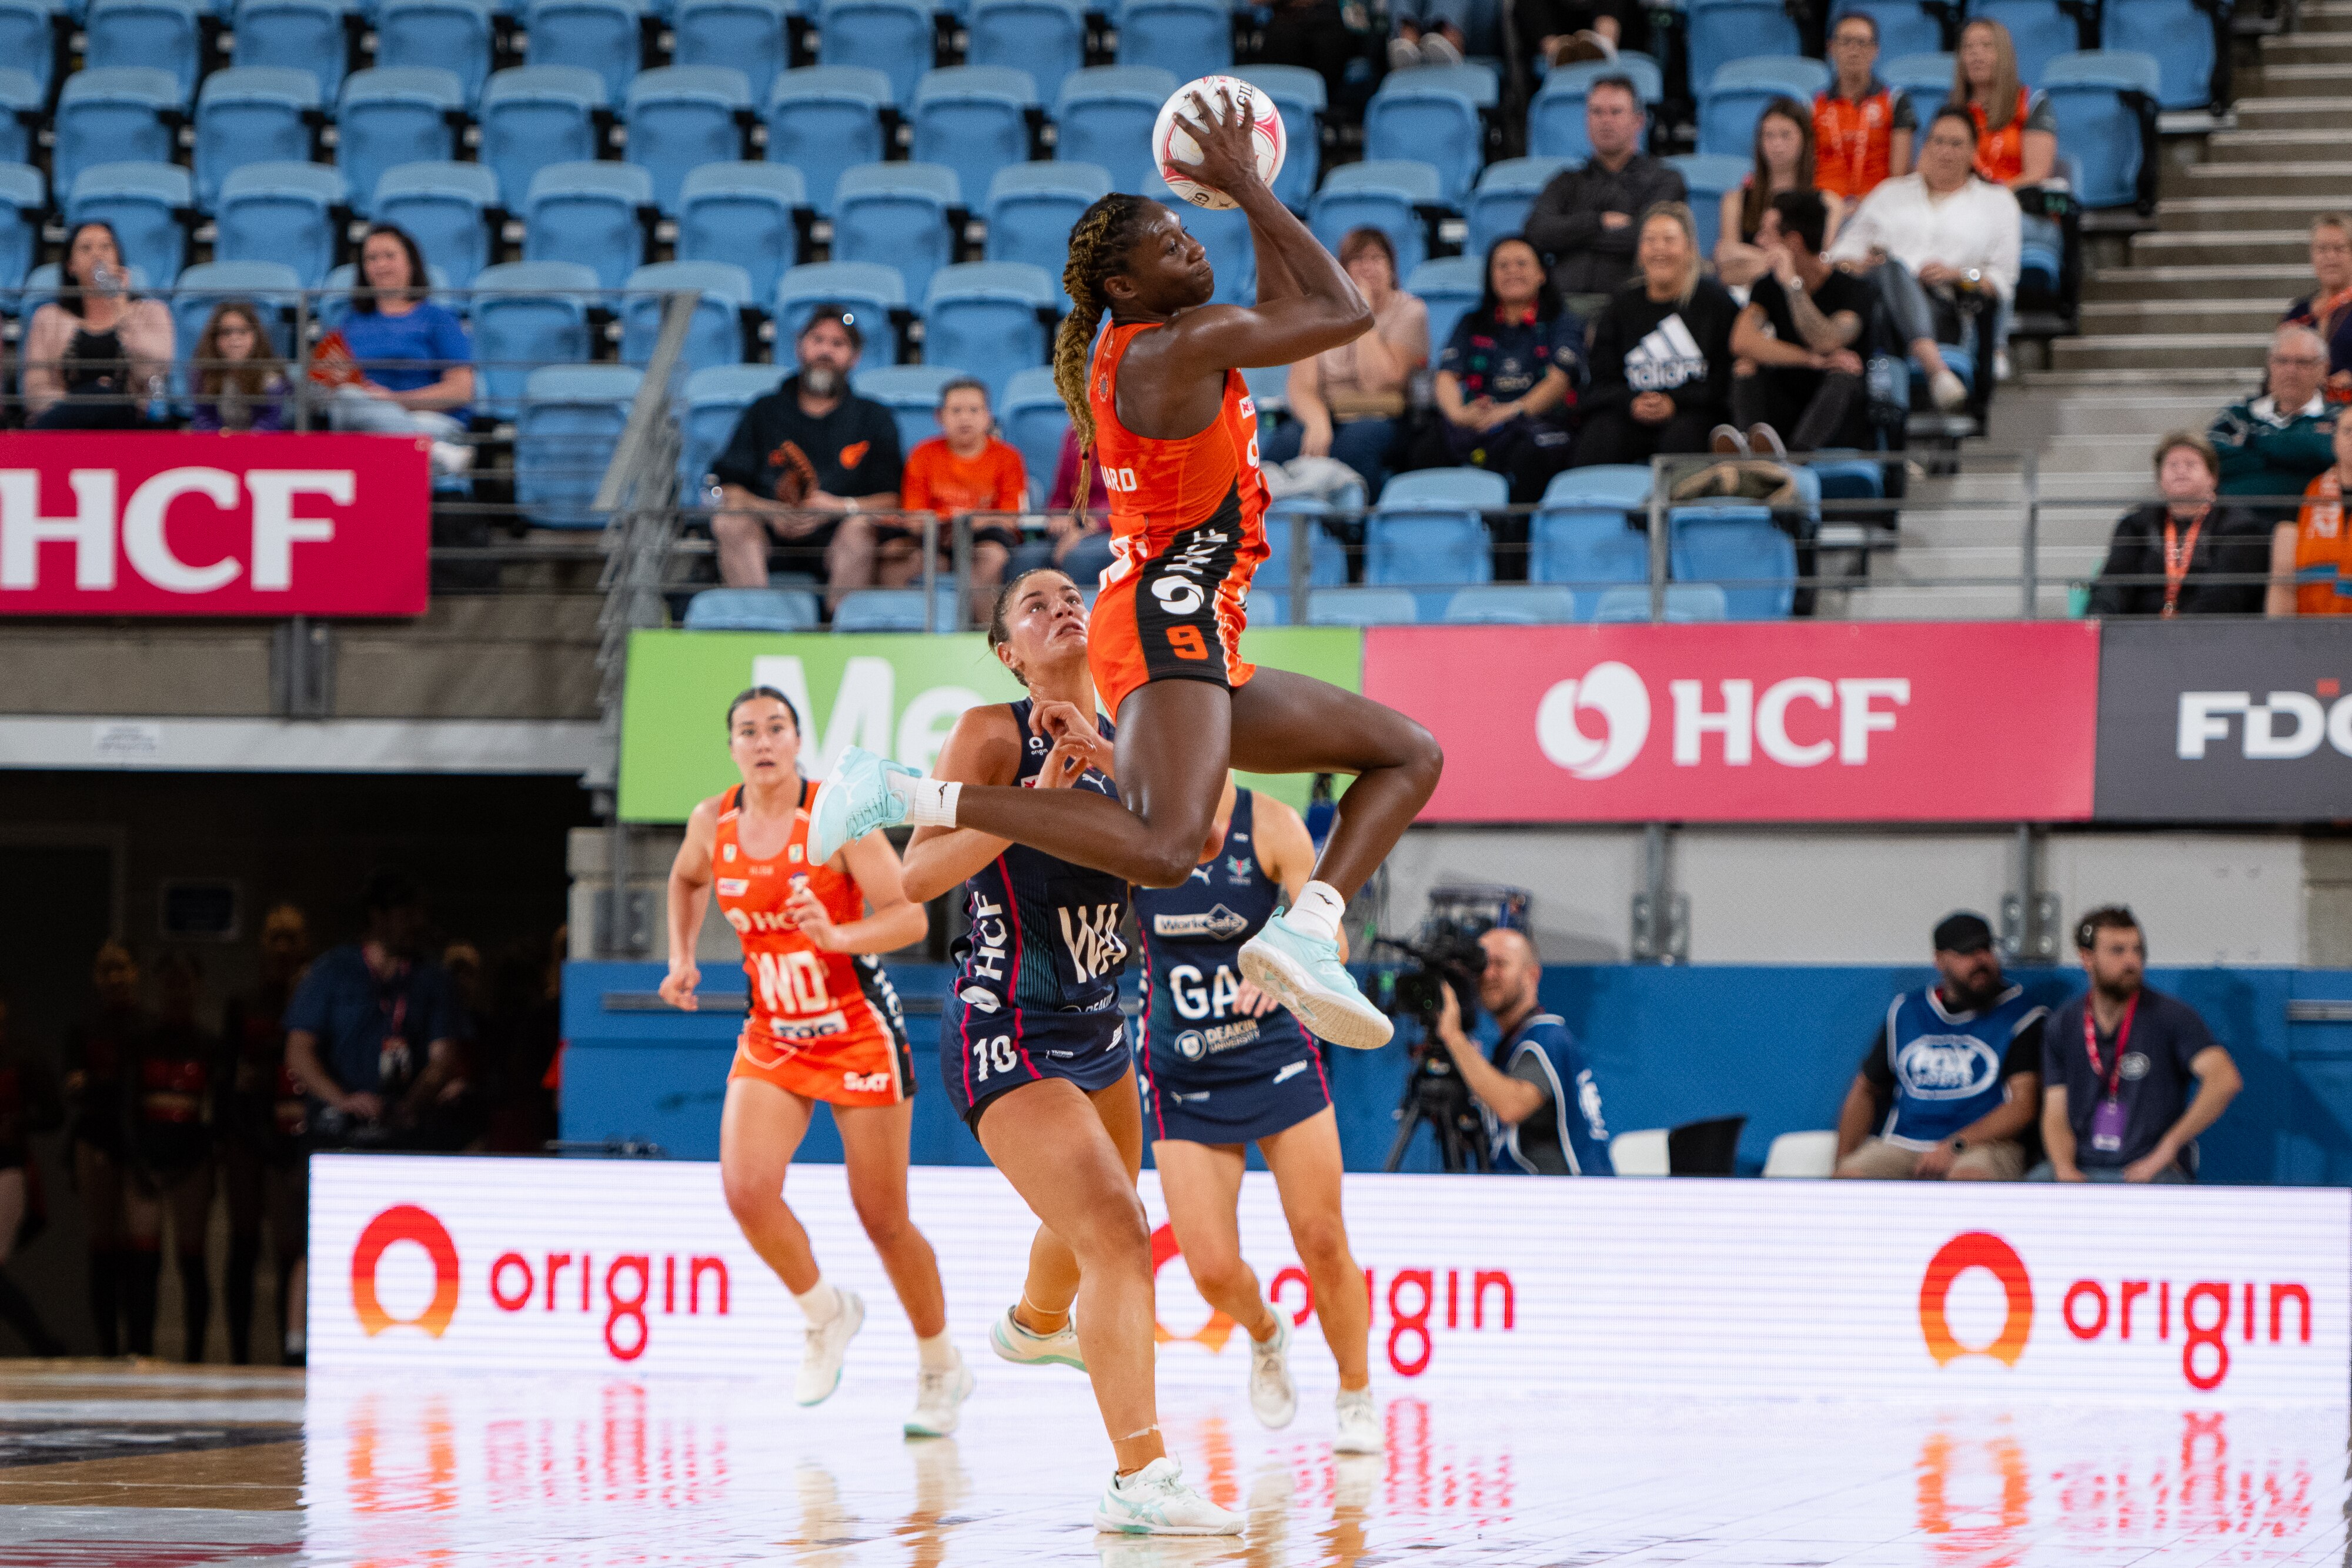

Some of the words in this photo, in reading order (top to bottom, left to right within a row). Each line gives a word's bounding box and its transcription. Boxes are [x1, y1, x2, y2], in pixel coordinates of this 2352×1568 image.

[1100, 466, 1137, 492] ARD
[0, 466, 356, 594] HCF
[1165, 624, 1209, 660] 9
[1669, 676, 1911, 767] HCF
[750, 911, 800, 931] HC
[973, 891, 1007, 981] HCF
[1057, 902, 1127, 984] WA
[749, 950, 830, 1014] WD
[1169, 964, 1240, 1020] GA
[973, 1034, 1018, 1082] 10
[1205, 1018, 1259, 1042] DEAKIN
[1207, 1029, 1260, 1054] UNIVERSITY
[490, 1252, 729, 1362] origin
[1270, 1266, 1516, 1376] oigin
[2063, 1279, 2311, 1390] origin
